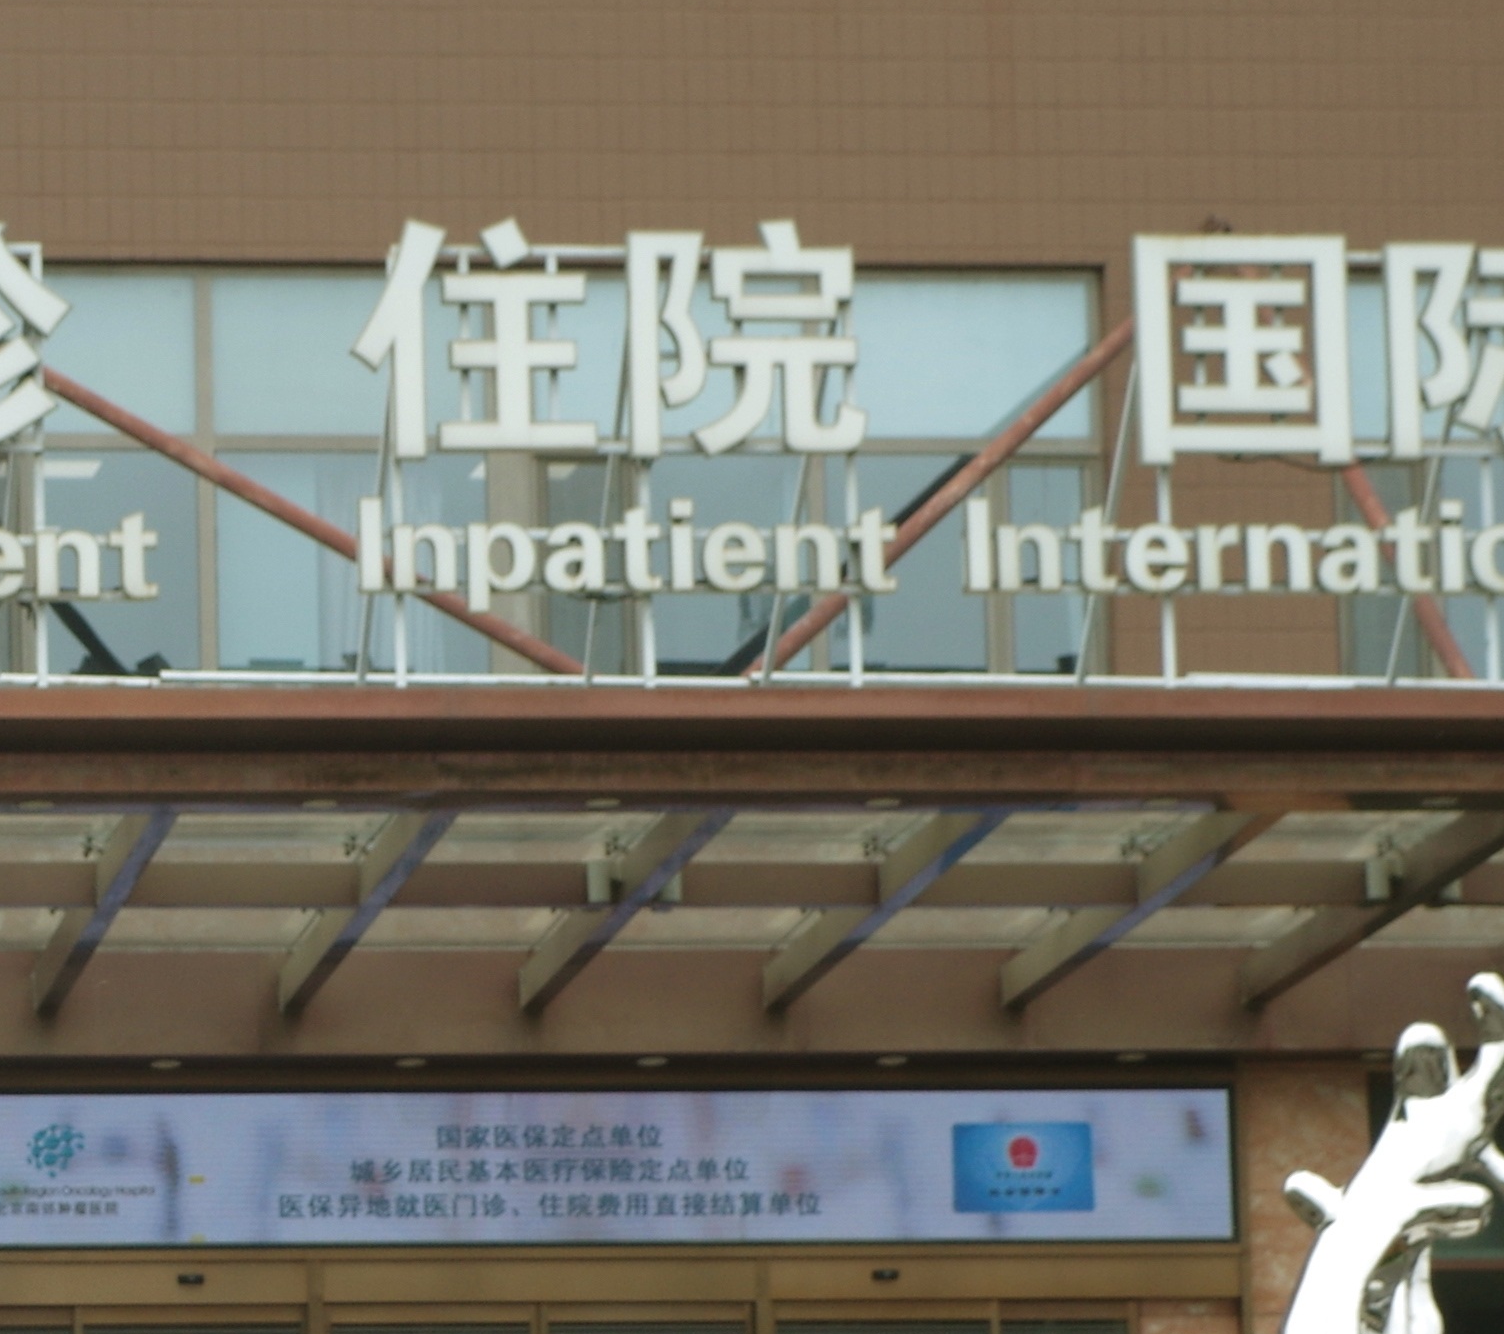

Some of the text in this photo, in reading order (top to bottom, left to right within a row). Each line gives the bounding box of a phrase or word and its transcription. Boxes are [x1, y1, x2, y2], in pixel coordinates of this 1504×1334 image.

[352, 217, 867, 459] 住院
[357, 497, 899, 613] Inpatient
[436, 1124, 663, 1149] 国家医保定点单位
